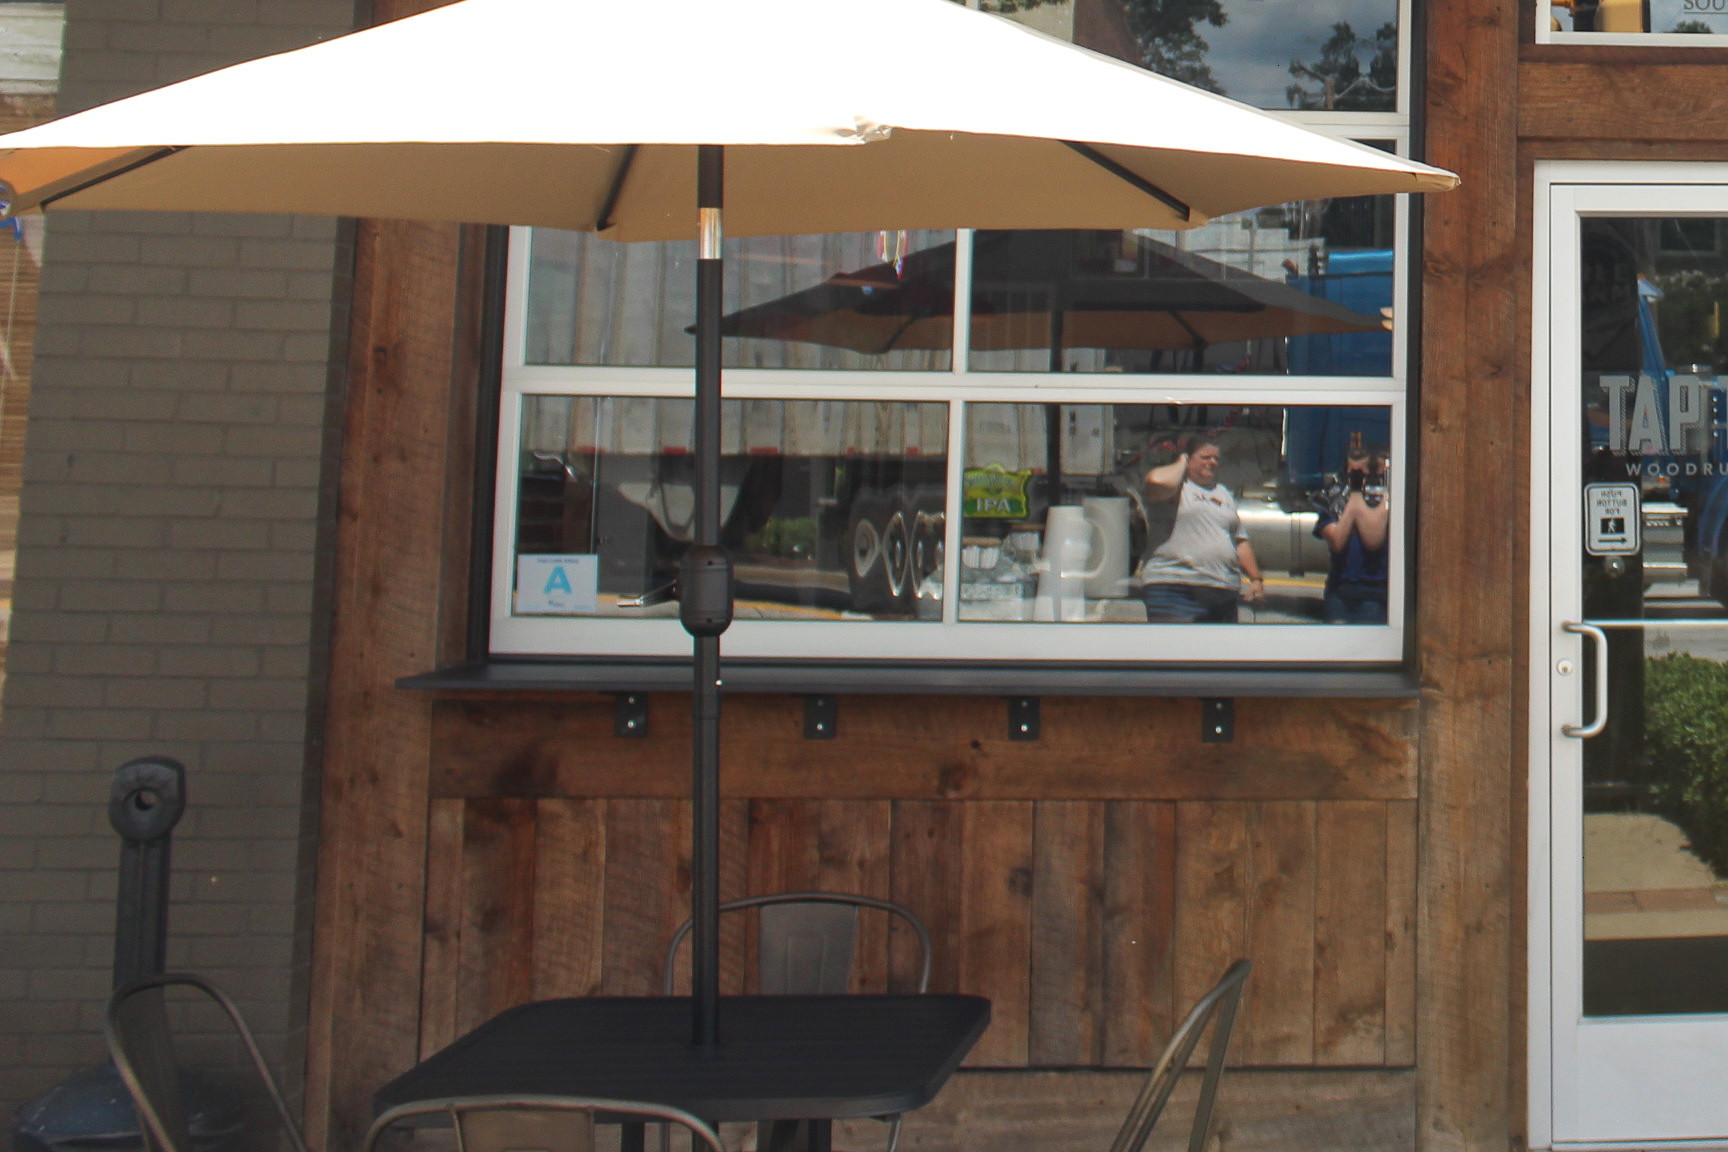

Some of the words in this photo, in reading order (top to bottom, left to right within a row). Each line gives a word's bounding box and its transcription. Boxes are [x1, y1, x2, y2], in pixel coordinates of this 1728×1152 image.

[1600, 374, 1703, 456] TAP
[976, 497, 1011, 513] IPA
[543, 565, 573, 594] A
